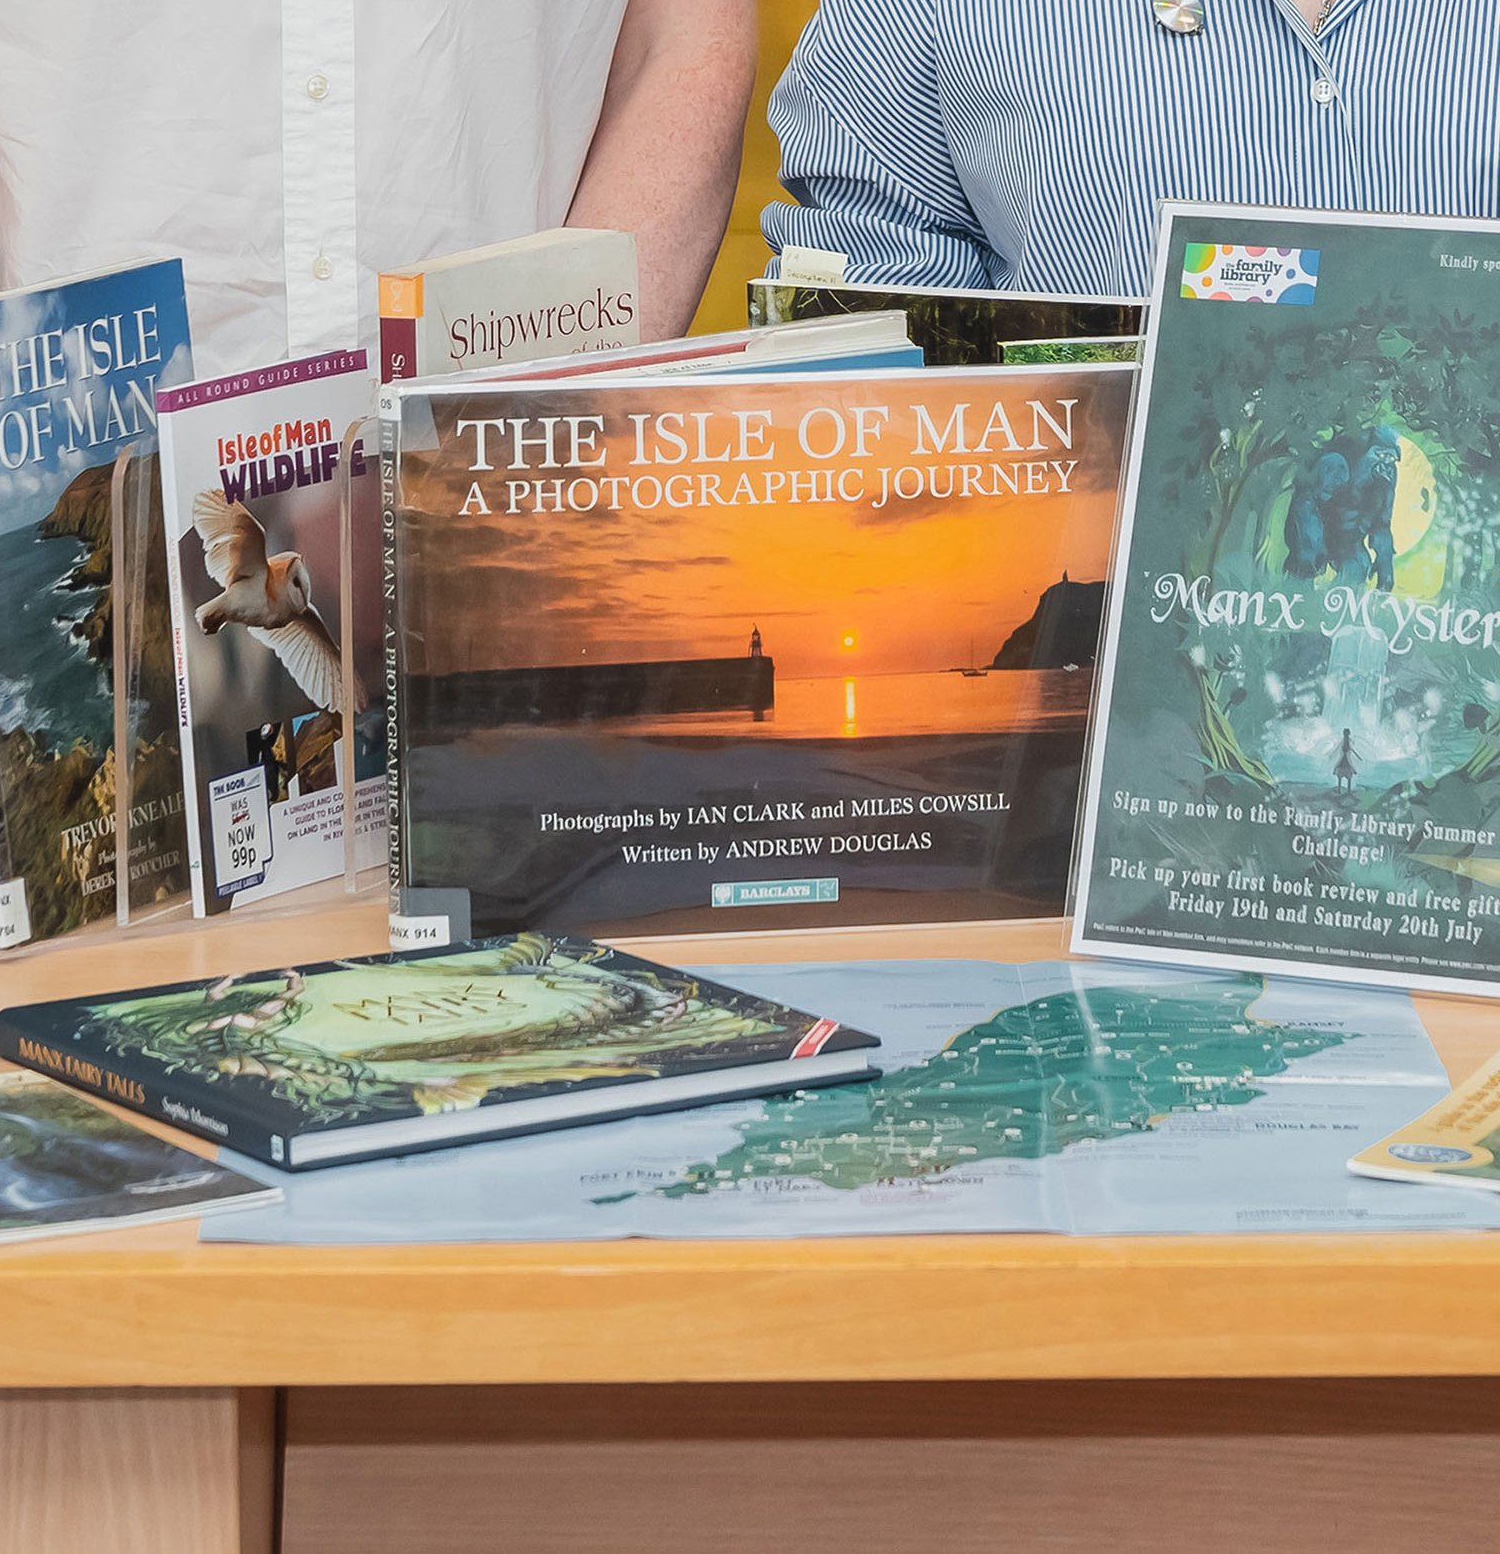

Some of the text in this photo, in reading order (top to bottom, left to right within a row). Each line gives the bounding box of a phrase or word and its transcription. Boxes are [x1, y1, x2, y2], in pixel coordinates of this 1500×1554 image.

[1220, 268, 1271, 285] library
[1235, 259, 1283, 275] family
[1439, 254, 1479, 270] Kindly
[75, 302, 161, 381] ISLE
[450, 287, 635, 360] Shipwrecks
[177, 355, 356, 405] ALL ROUND GUIDE SERIES
[62, 374, 158, 454] MAN
[456, 398, 1080, 471] THE ISLE OF MAN
[217, 417, 333, 467] Isle of Man
[219, 439, 368, 506] WILDLIFE
[457, 459, 1079, 517] A PHOTOGRAPHIC JOURNEY
[384, 548, 396, 601] MAN
[1150, 572, 1306, 627] Manx
[61, 812, 118, 850] TREVOR
[129, 792, 187, 830] KNEALE
[230, 796, 248, 812] WAS
[540, 792, 1011, 833] Photographs by IAN CLARK and MILES COWSILL
[1112, 790, 1151, 816] Sign
[1158, 800, 1178, 819] up
[1185, 803, 1220, 819] now
[1226, 804, 1243, 821] to
[1250, 804, 1278, 823] the
[1283, 806, 1344, 834] Family
[1350, 812, 1415, 842] Library
[1423, 820, 1495, 846] Summer
[227, 824, 256, 848] NOW
[231, 846, 257, 869] 99p
[621, 831, 933, 865] Written by ANDREW DOUGLAS
[1292, 834, 1385, 865] Challenge!
[81, 872, 116, 897] DEREK
[739, 884, 811, 900] BARCLAYS
[1109, 857, 1148, 881] Pick
[1154, 866, 1174, 886] up
[1181, 870, 1221, 889] your
[1226, 869, 1266, 892] first
[1272, 874, 1314, 898] book
[1320, 882, 1380, 905] review
[1385, 889, 1418, 908] and
[1425, 890, 1461, 912] free
[1467, 895, 1500, 918] gift
[414, 927, 437, 939] 914
[1168, 891, 1484, 945] Friday 19th and Saturday 20th July
[19, 1036, 146, 1105] MANX FAIRY TALES
